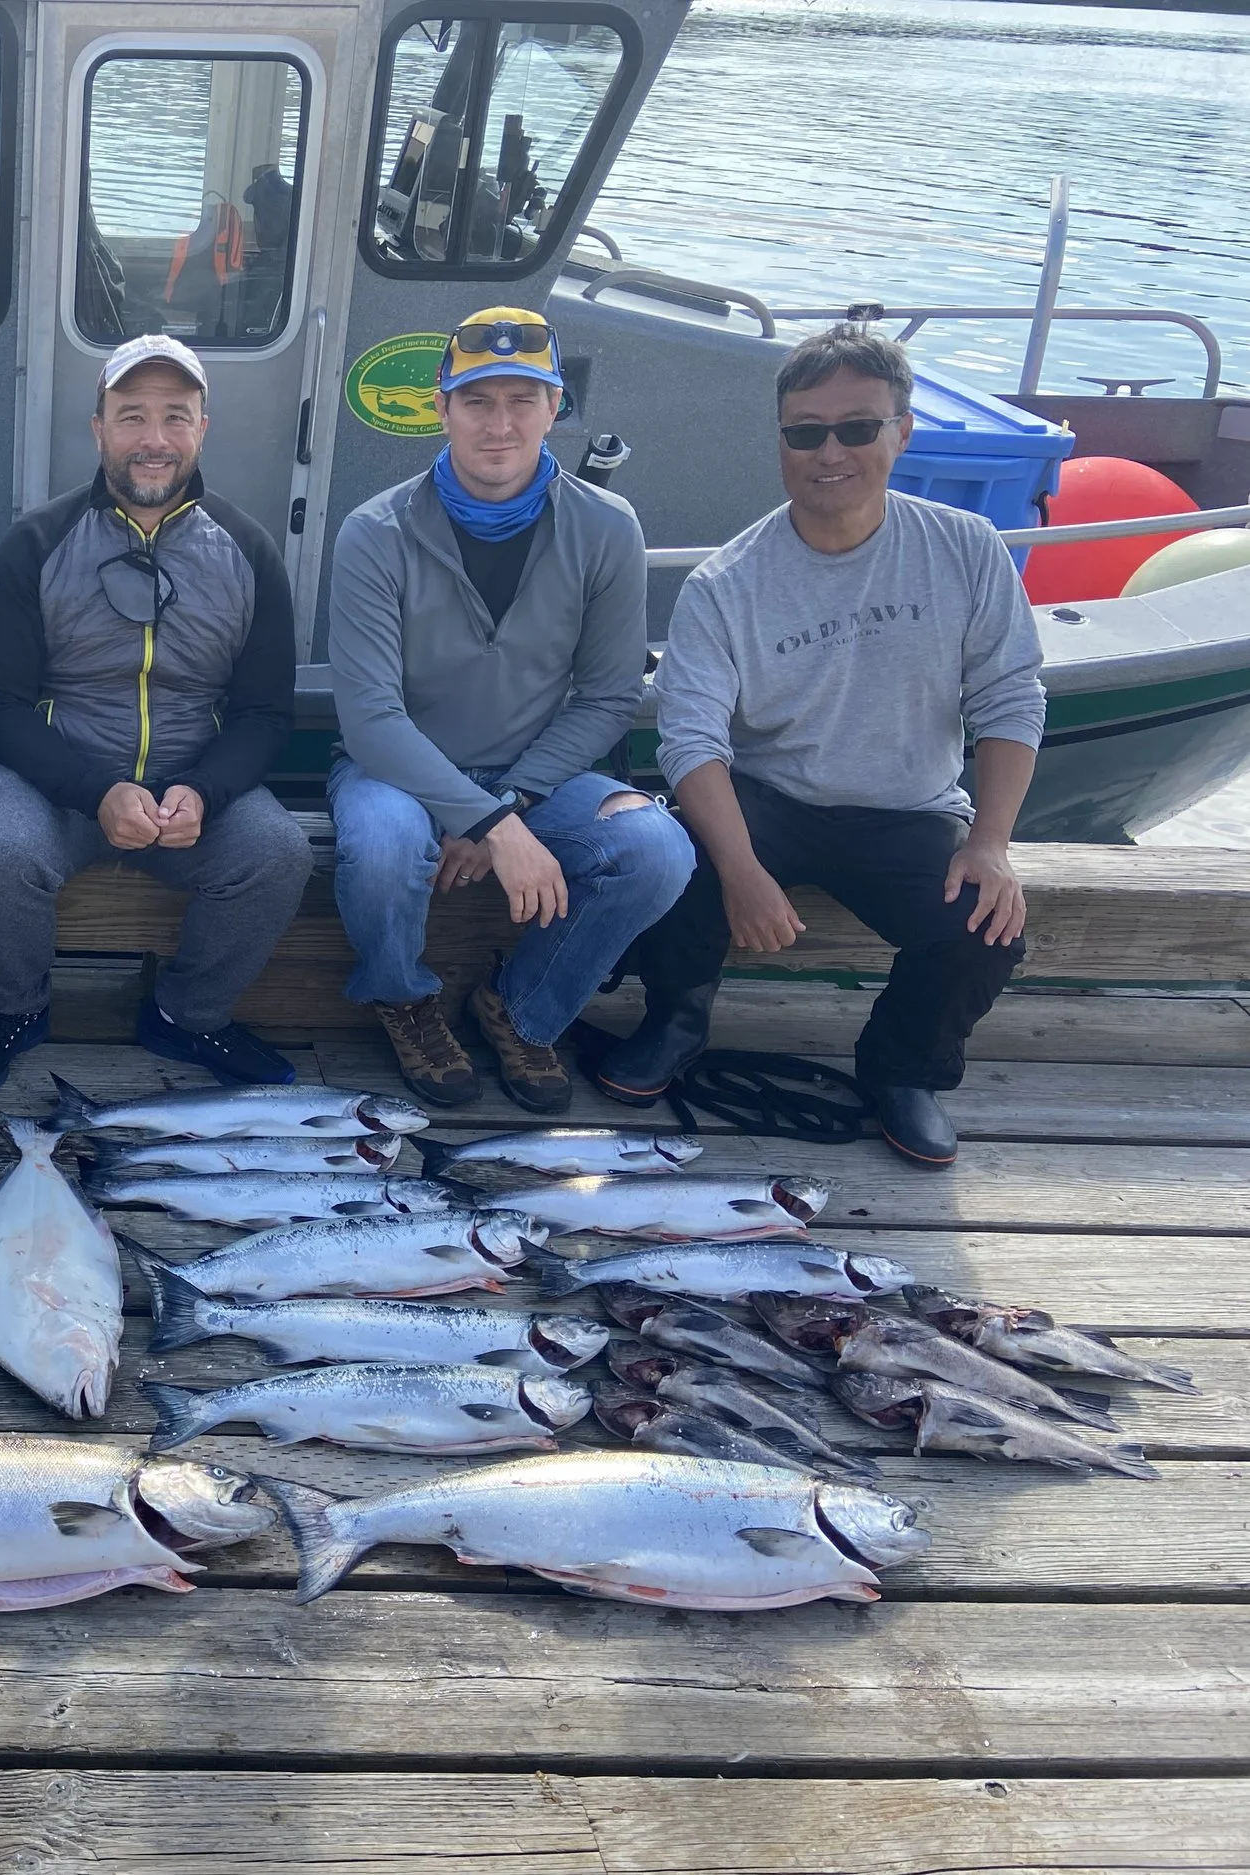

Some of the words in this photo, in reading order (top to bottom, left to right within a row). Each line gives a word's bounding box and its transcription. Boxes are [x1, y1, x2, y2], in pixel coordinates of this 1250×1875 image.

[357, 352, 381, 371] Alaska
[381, 340, 428, 354] Department
[429, 339, 438, 347] of
[370, 416, 391, 429] Sport
[391, 424, 419, 433] Fishing
[776, 619, 841, 655] OLD
[849, 603, 929, 630] NAVY
